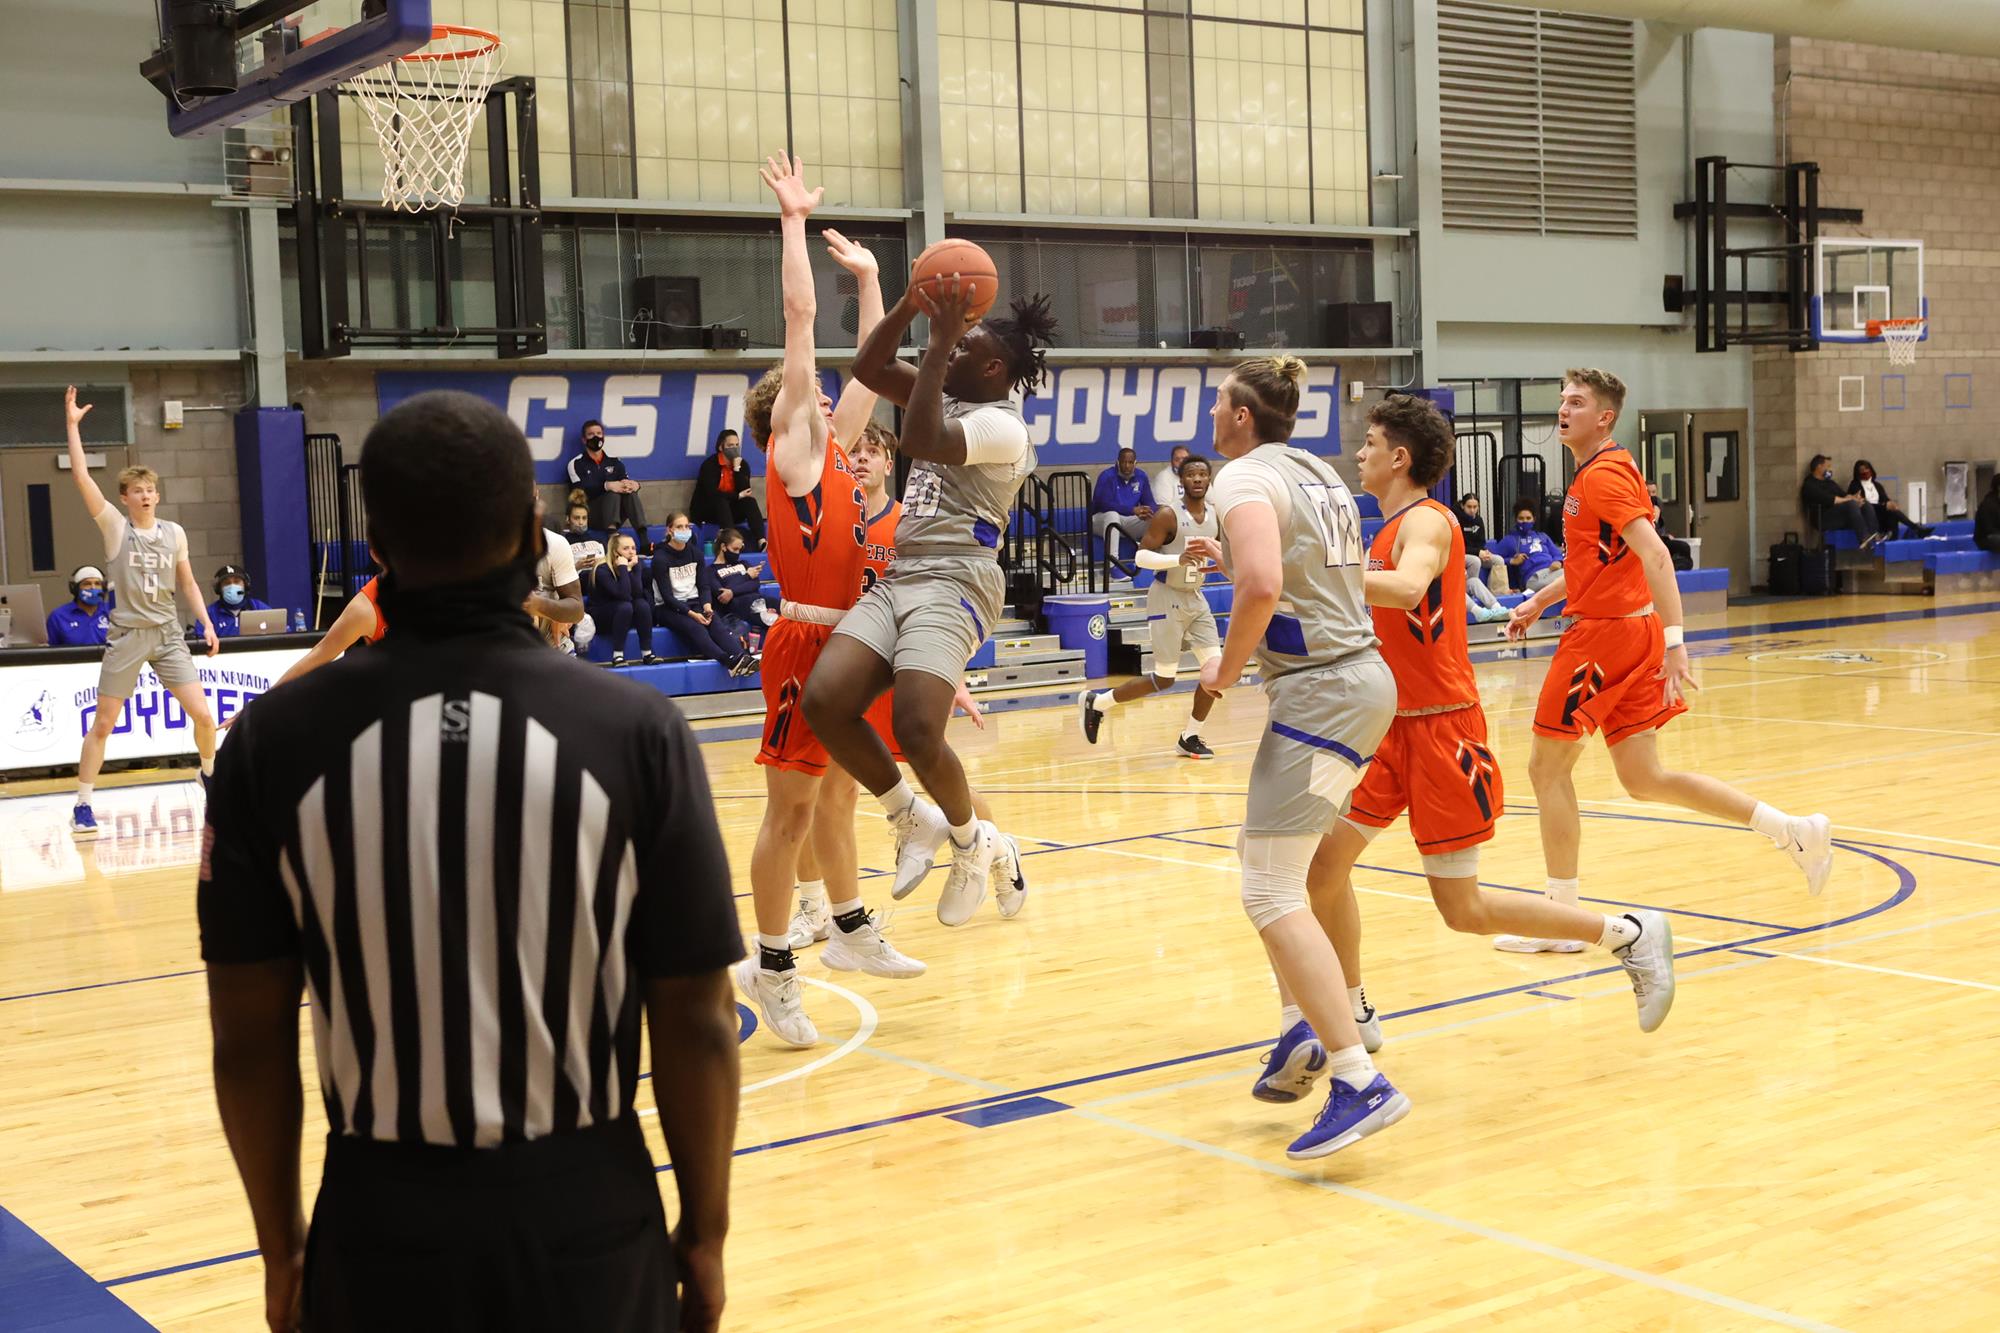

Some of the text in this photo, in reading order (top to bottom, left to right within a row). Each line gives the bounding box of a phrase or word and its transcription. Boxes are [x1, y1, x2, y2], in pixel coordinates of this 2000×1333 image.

[1008, 366, 1336, 450] COYOS
[128, 551, 174, 569] CSN
[142, 571, 161, 603] 4
[221, 669, 271, 692] NEVADA
